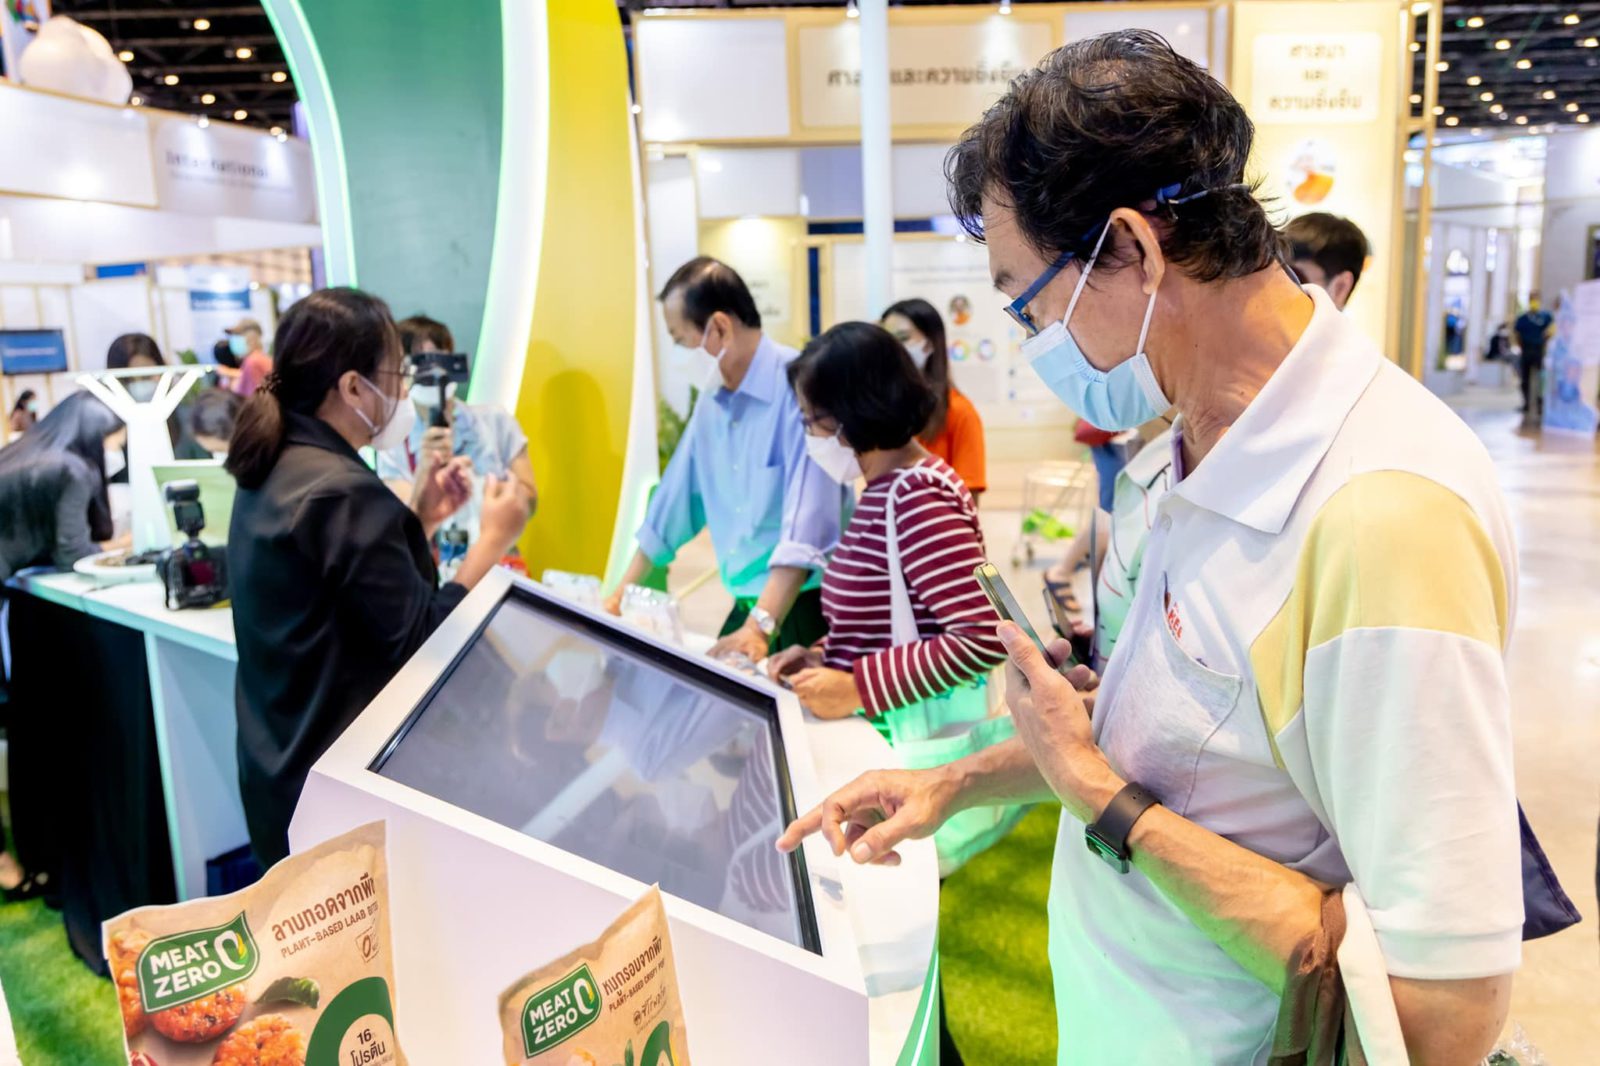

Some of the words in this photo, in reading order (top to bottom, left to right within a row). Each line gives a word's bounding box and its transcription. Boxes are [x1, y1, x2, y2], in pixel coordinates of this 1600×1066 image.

[281, 920, 344, 958] PLANT-BASED
[344, 909, 366, 927] LAAB
[149, 940, 209, 975] MEAT
[153, 961, 221, 998] ZERO
[529, 988, 571, 1026] MEAT
[357, 1028, 372, 1045] 16
[532, 1007, 578, 1045] ZERO
